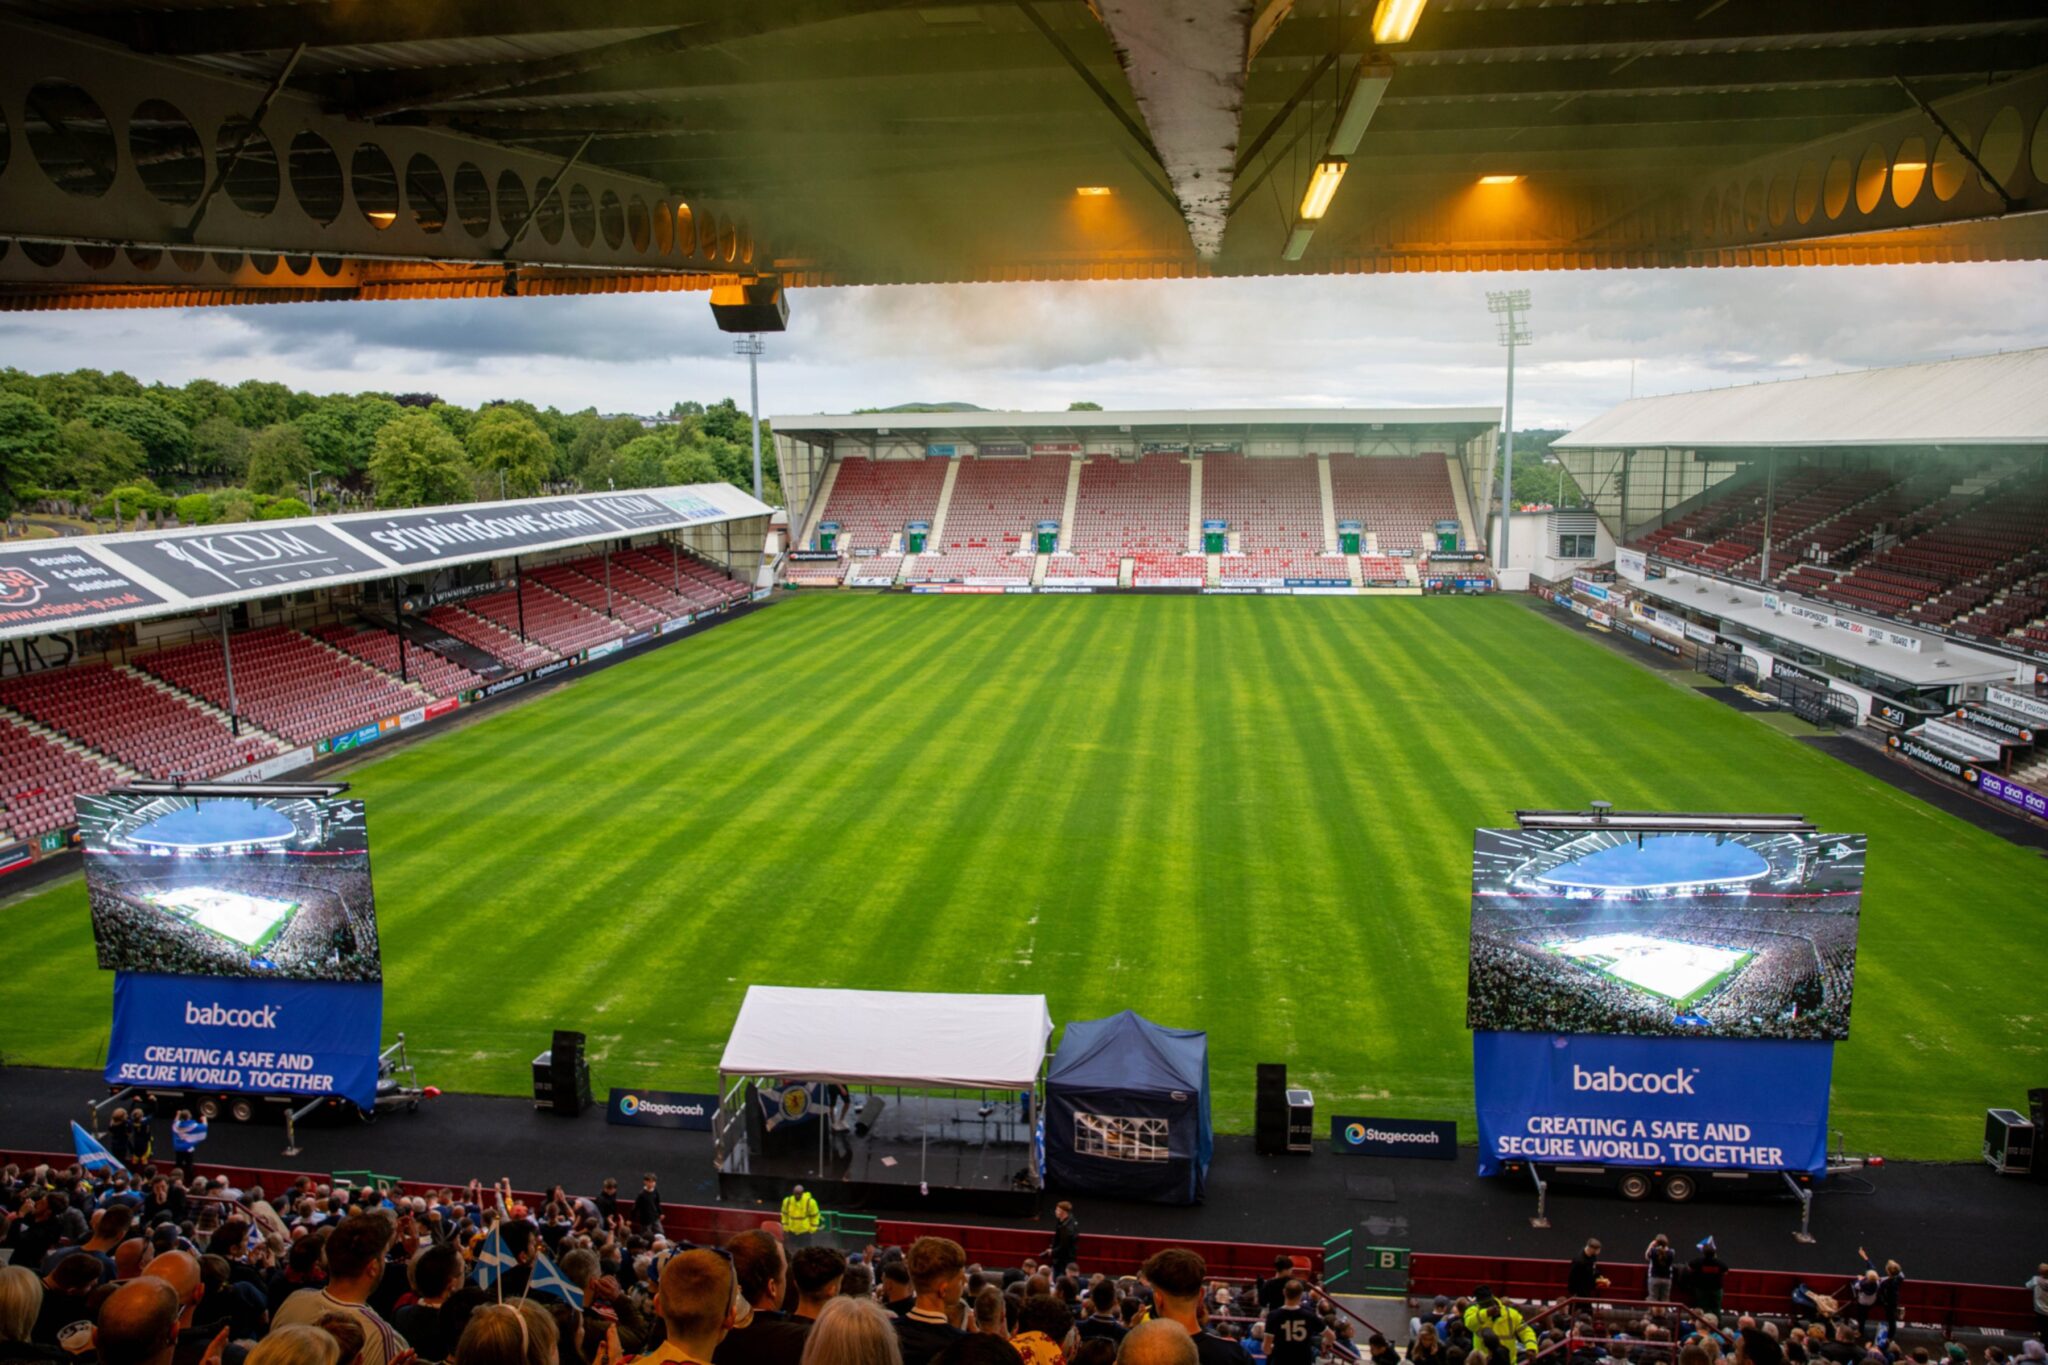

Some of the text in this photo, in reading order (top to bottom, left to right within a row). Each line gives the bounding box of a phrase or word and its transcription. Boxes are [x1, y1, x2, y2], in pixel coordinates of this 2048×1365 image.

[183, 530, 327, 565] KDM
[29, 554, 87, 567] Security
[64, 566, 109, 578] Safety
[68, 578, 130, 592] Solutions
[144, 1046, 313, 1070] CREATING A SAFE AND
[119, 1063, 333, 1091] SECURE WORLD, TOGETHER
[638, 1100, 704, 1116] Stagecoach
[1365, 1128, 1439, 1144] Stagecoach
[1527, 1116, 1751, 1142] CREATING A SAFE AND
[1498, 1136, 1784, 1166] SECURE WORLD, TOGETHER
[1380, 1252, 1395, 1268] B
[1281, 1320, 1307, 1342] 15
